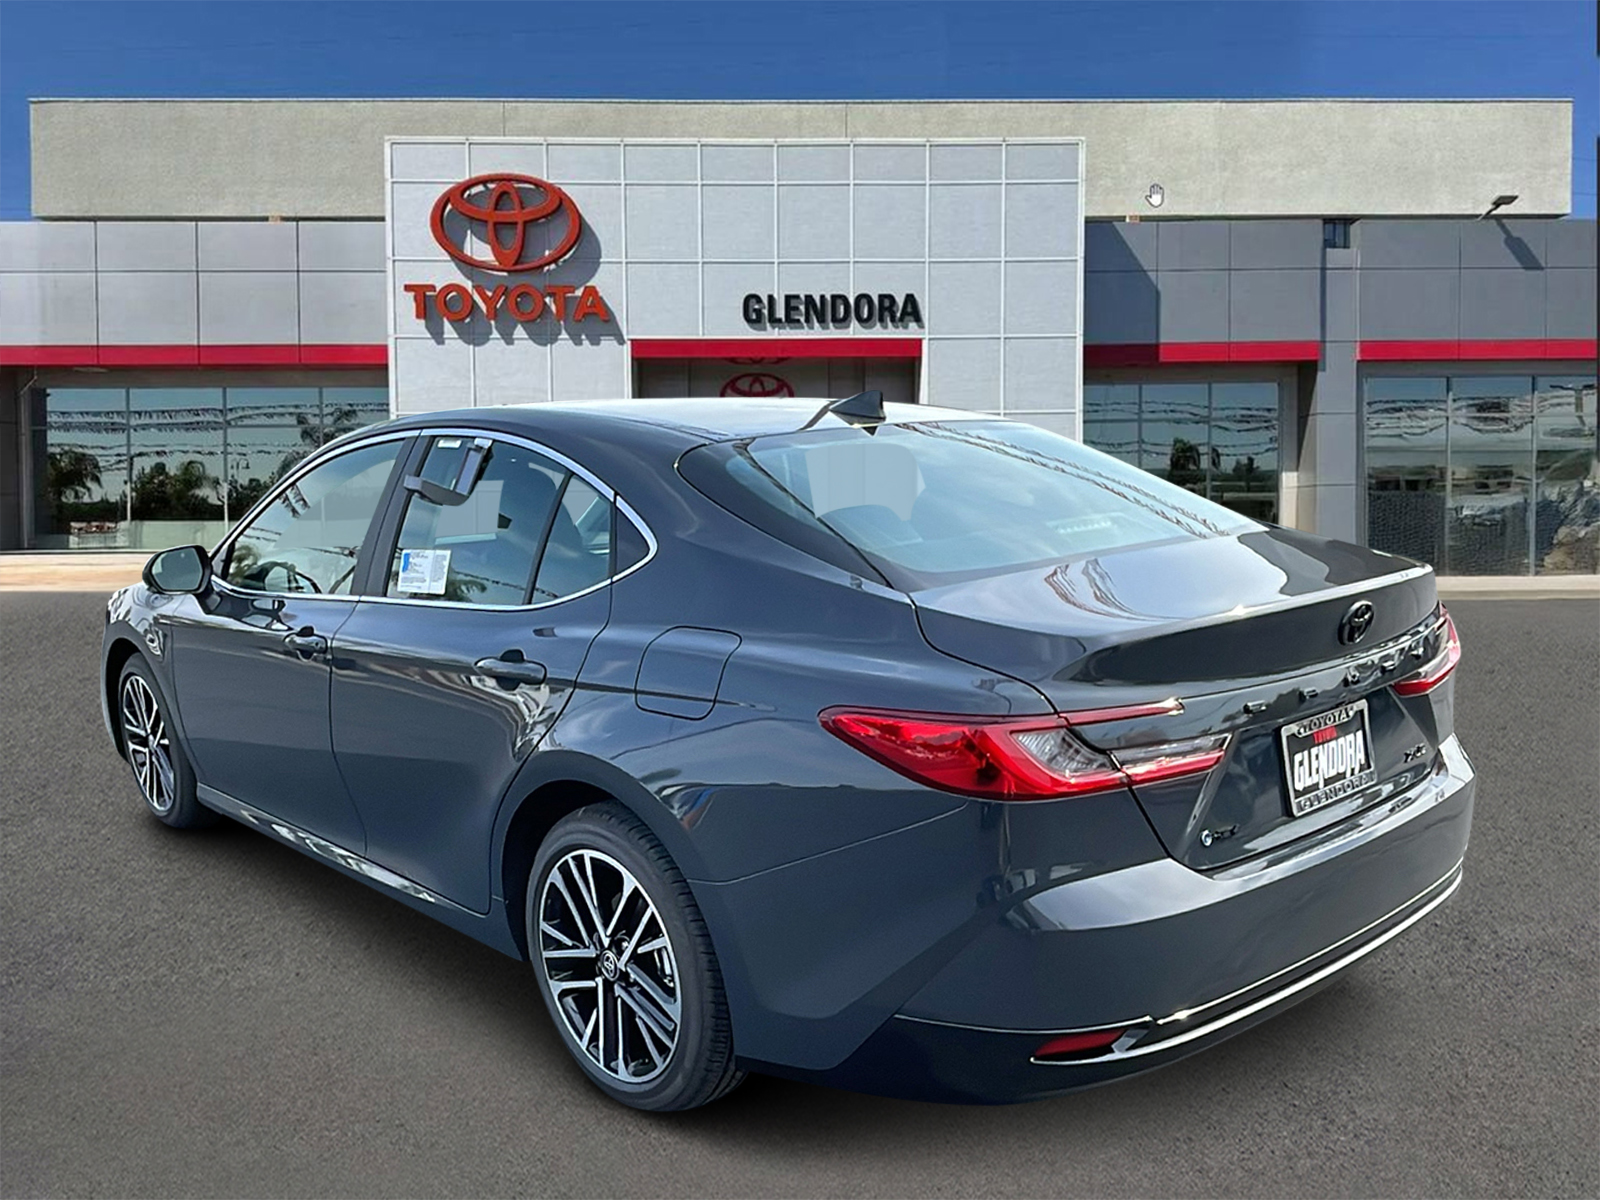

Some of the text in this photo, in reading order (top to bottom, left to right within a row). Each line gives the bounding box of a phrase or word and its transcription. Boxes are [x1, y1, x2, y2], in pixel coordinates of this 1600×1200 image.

[404, 283, 609, 323] TOYOTA
[743, 293, 923, 325] GLENDORA
[1302, 708, 1349, 732] TOYOTA
[1294, 729, 1365, 791] GLENDORA
